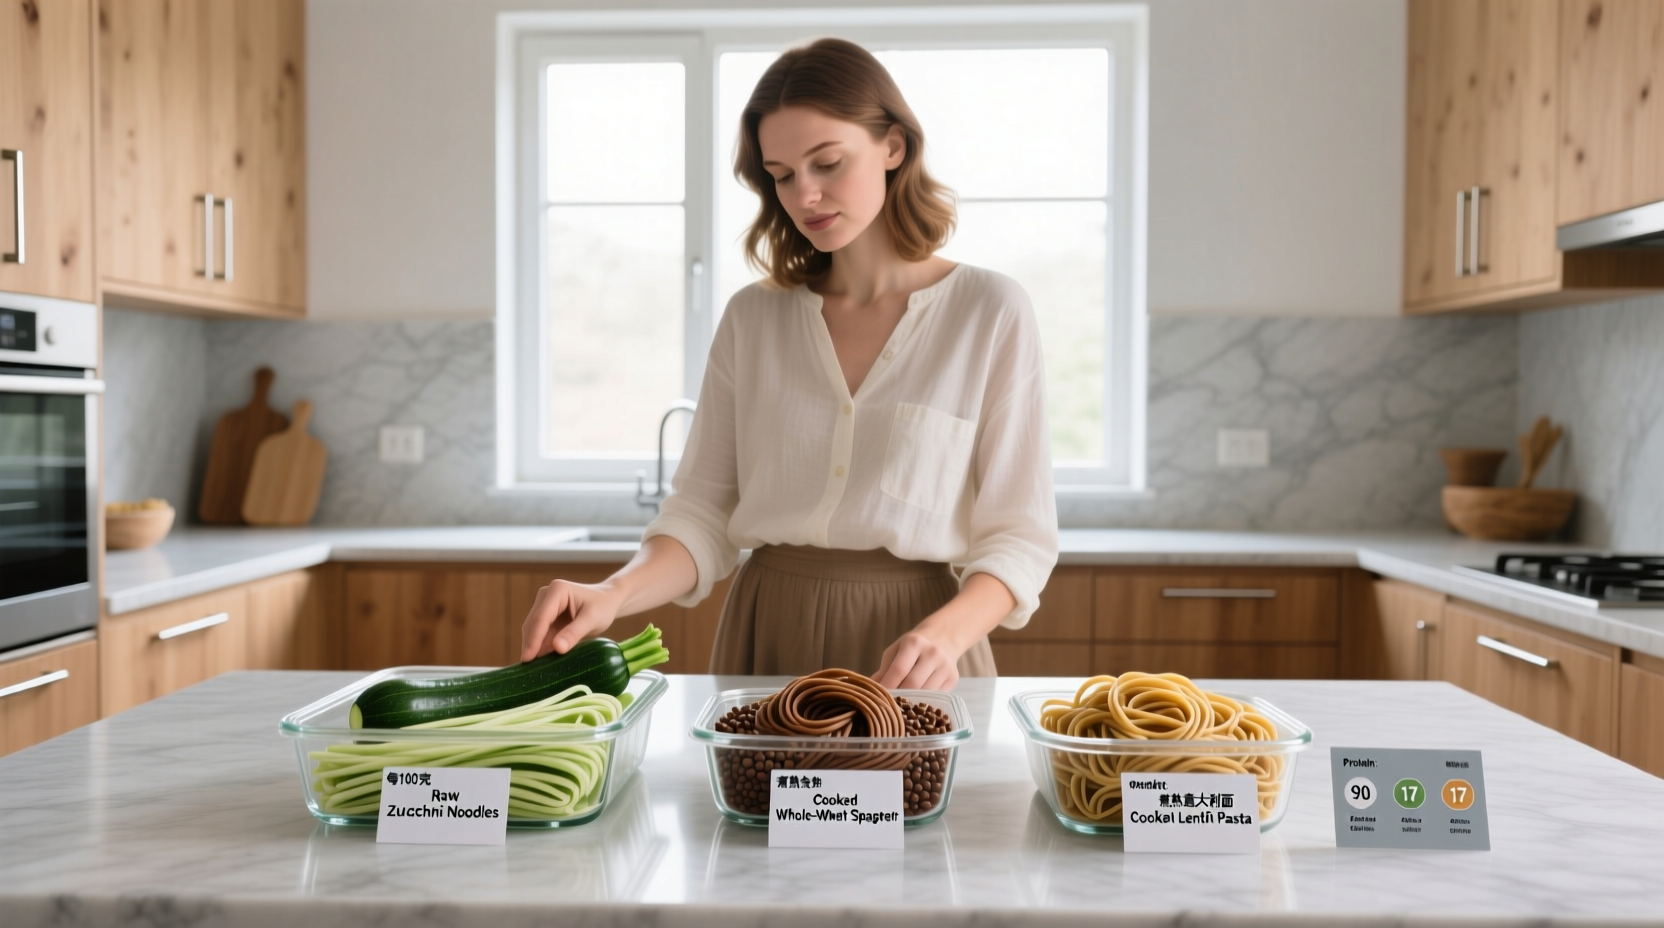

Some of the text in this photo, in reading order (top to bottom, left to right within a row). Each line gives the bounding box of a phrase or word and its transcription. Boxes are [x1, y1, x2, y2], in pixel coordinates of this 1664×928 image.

[431, 789, 460, 802] Raw
[1351, 785, 1371, 801] 90
[1401, 786, 1418, 803] 17
[1450, 787, 1467, 804] 17
[447, 805, 499, 818] Noodles
[1217, 811, 1253, 825] Pasta
